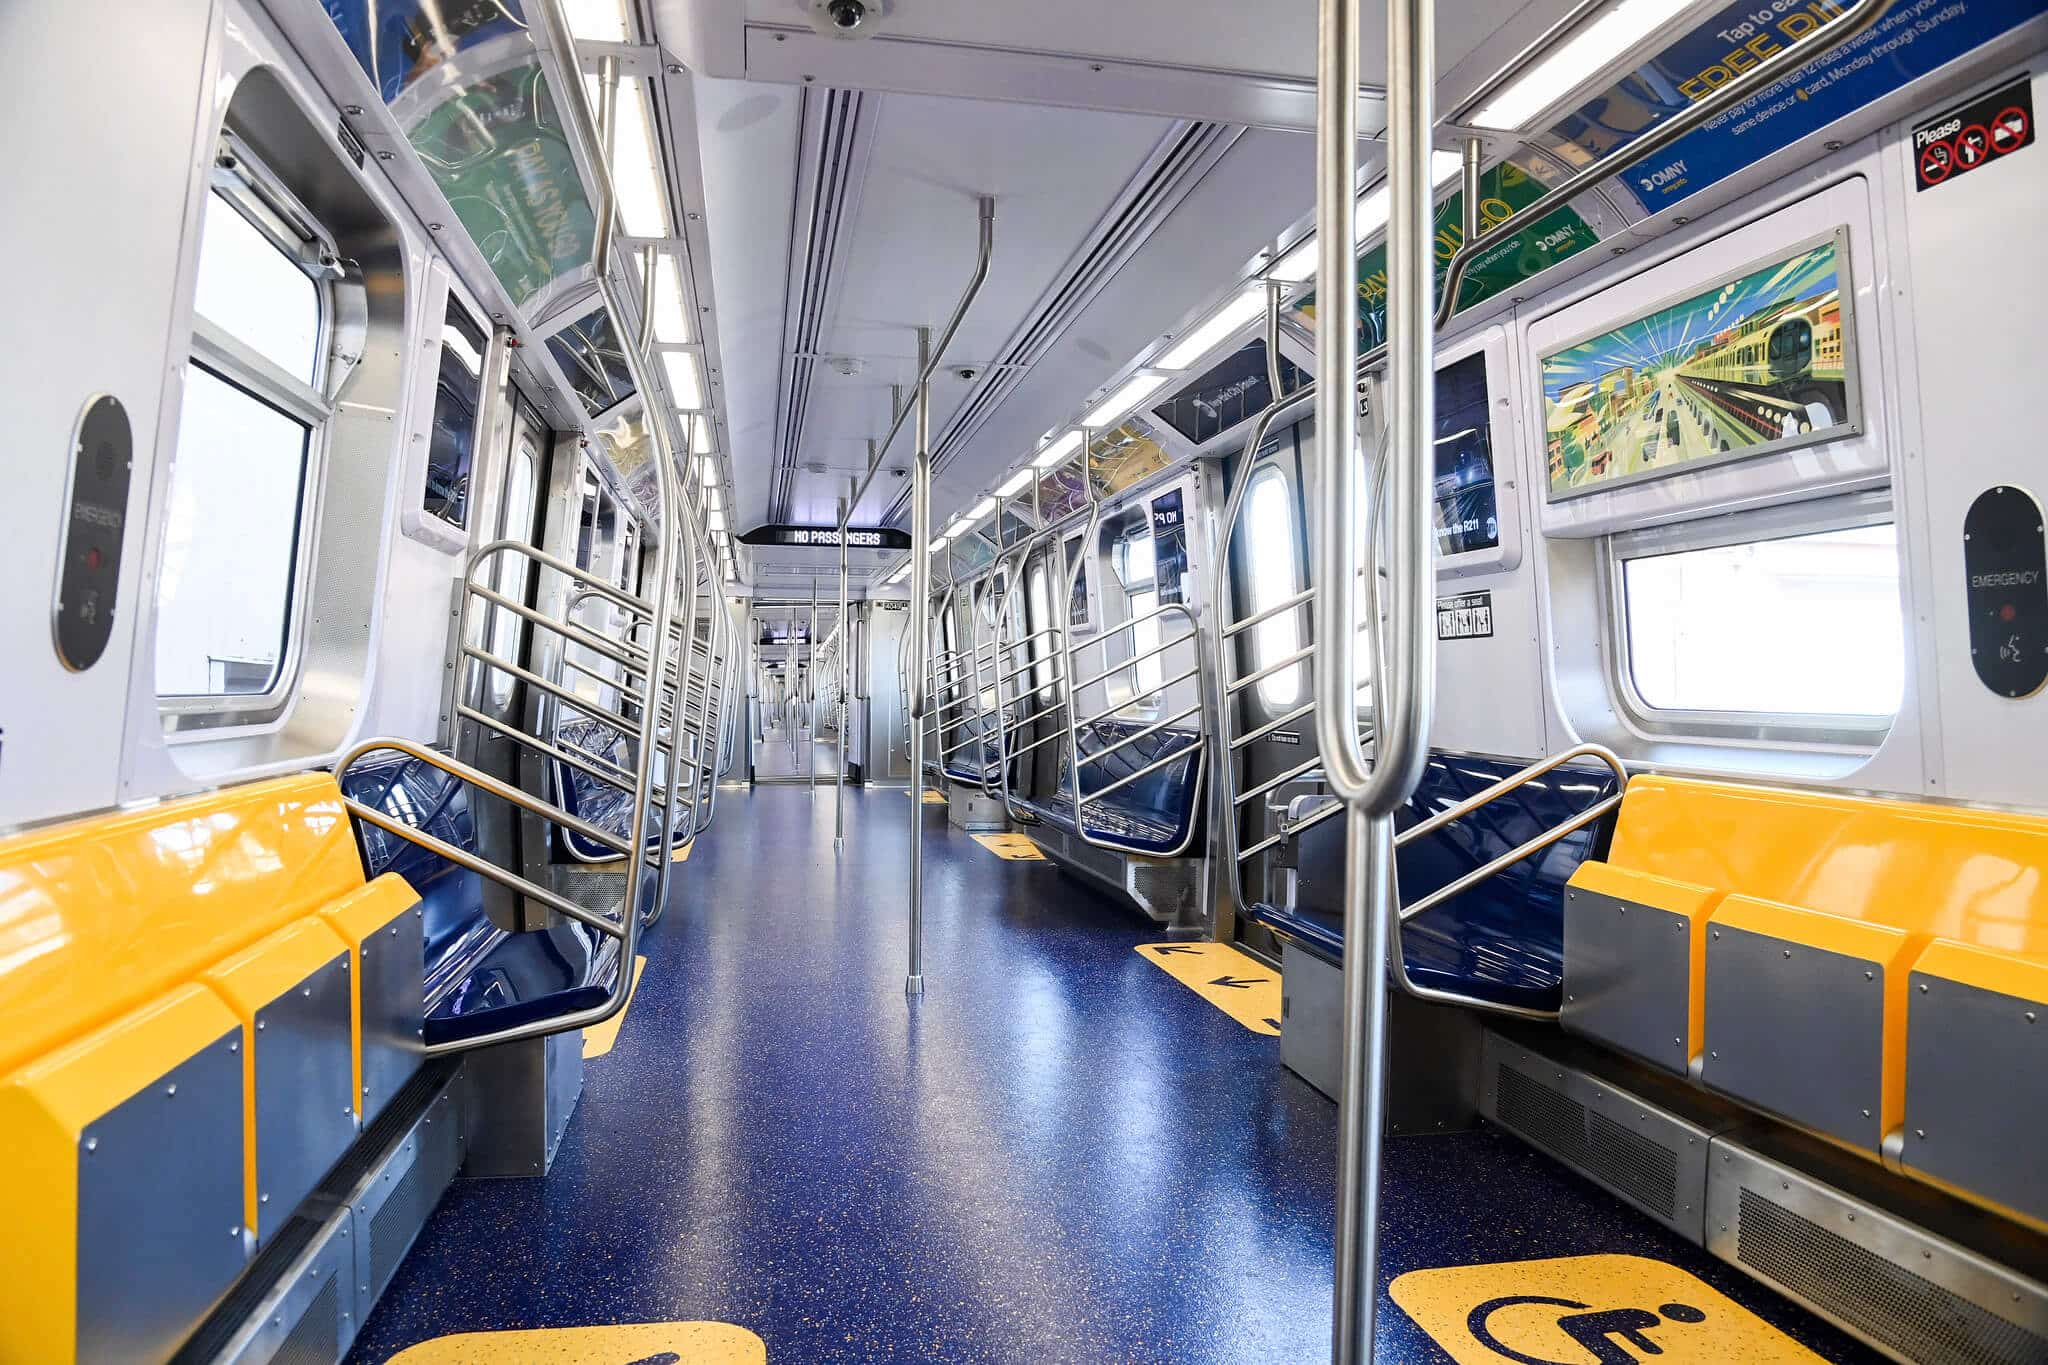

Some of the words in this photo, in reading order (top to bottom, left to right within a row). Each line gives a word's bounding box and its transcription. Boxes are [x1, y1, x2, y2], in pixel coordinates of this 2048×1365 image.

[1717, 19, 1755, 44] Tap
[1749, 9, 1773, 25] to
[1678, 33, 1782, 100] FREE
[1702, 111, 1729, 132] Never
[1728, 105, 1746, 119] pay
[1758, 84, 1783, 102] more
[1782, 70, 1803, 88] than
[1816, 49, 1842, 68] rides
[1841, 45, 1850, 56] a
[1880, 10, 1912, 32] when
[1731, 118, 1757, 135] same
[1755, 101, 1787, 122] device
[1786, 95, 1797, 106] or
[1828, 51, 1874, 82] Monday
[1871, 26, 1920, 58] through
[1916, 119, 1960, 149] Please
[1651, 159, 1688, 186] OMNY
[1544, 224, 1575, 247] OMNY
[794, 530, 809, 544] NO
[811, 531, 881, 545] PASSNGERS
[1464, 518, 1479, 533] R211
[1972, 570, 2039, 588] EMERGENCY
